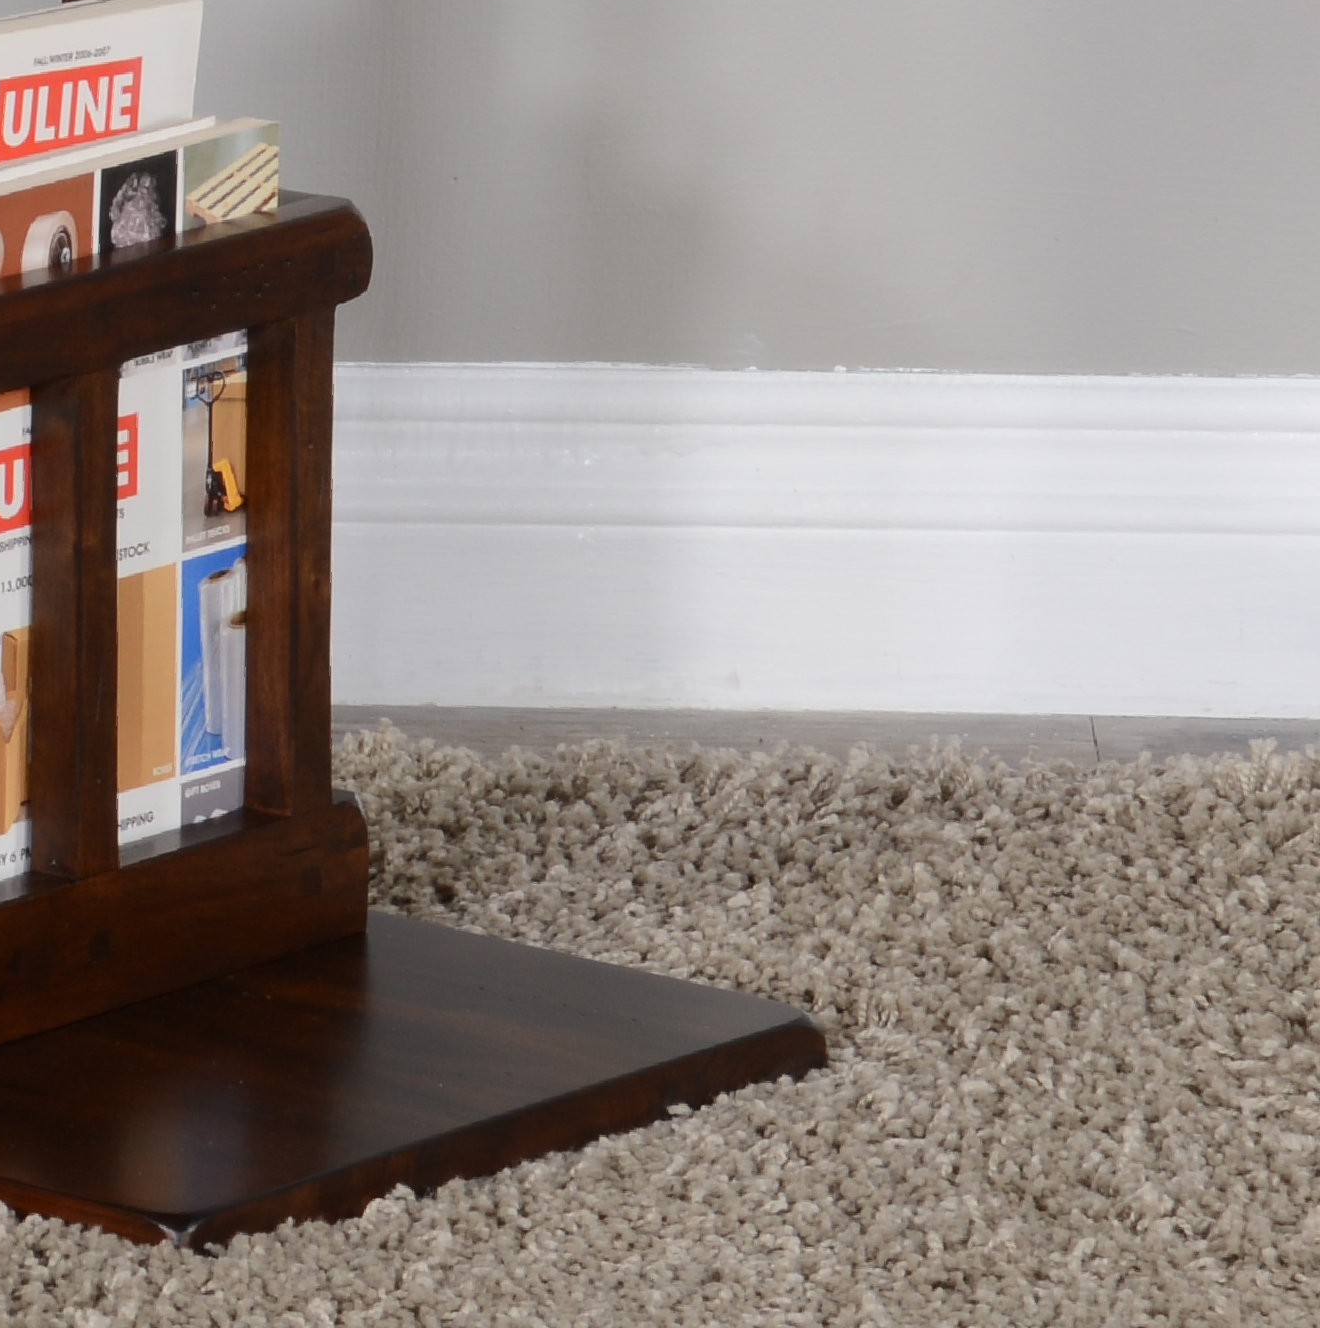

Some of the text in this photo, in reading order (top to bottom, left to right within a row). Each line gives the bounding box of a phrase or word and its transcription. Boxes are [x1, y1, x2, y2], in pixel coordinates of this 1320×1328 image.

[2, 72, 134, 147] ULINE
[0, 536, 32, 552] SHIPPIN
[119, 541, 150, 561] STOCK
